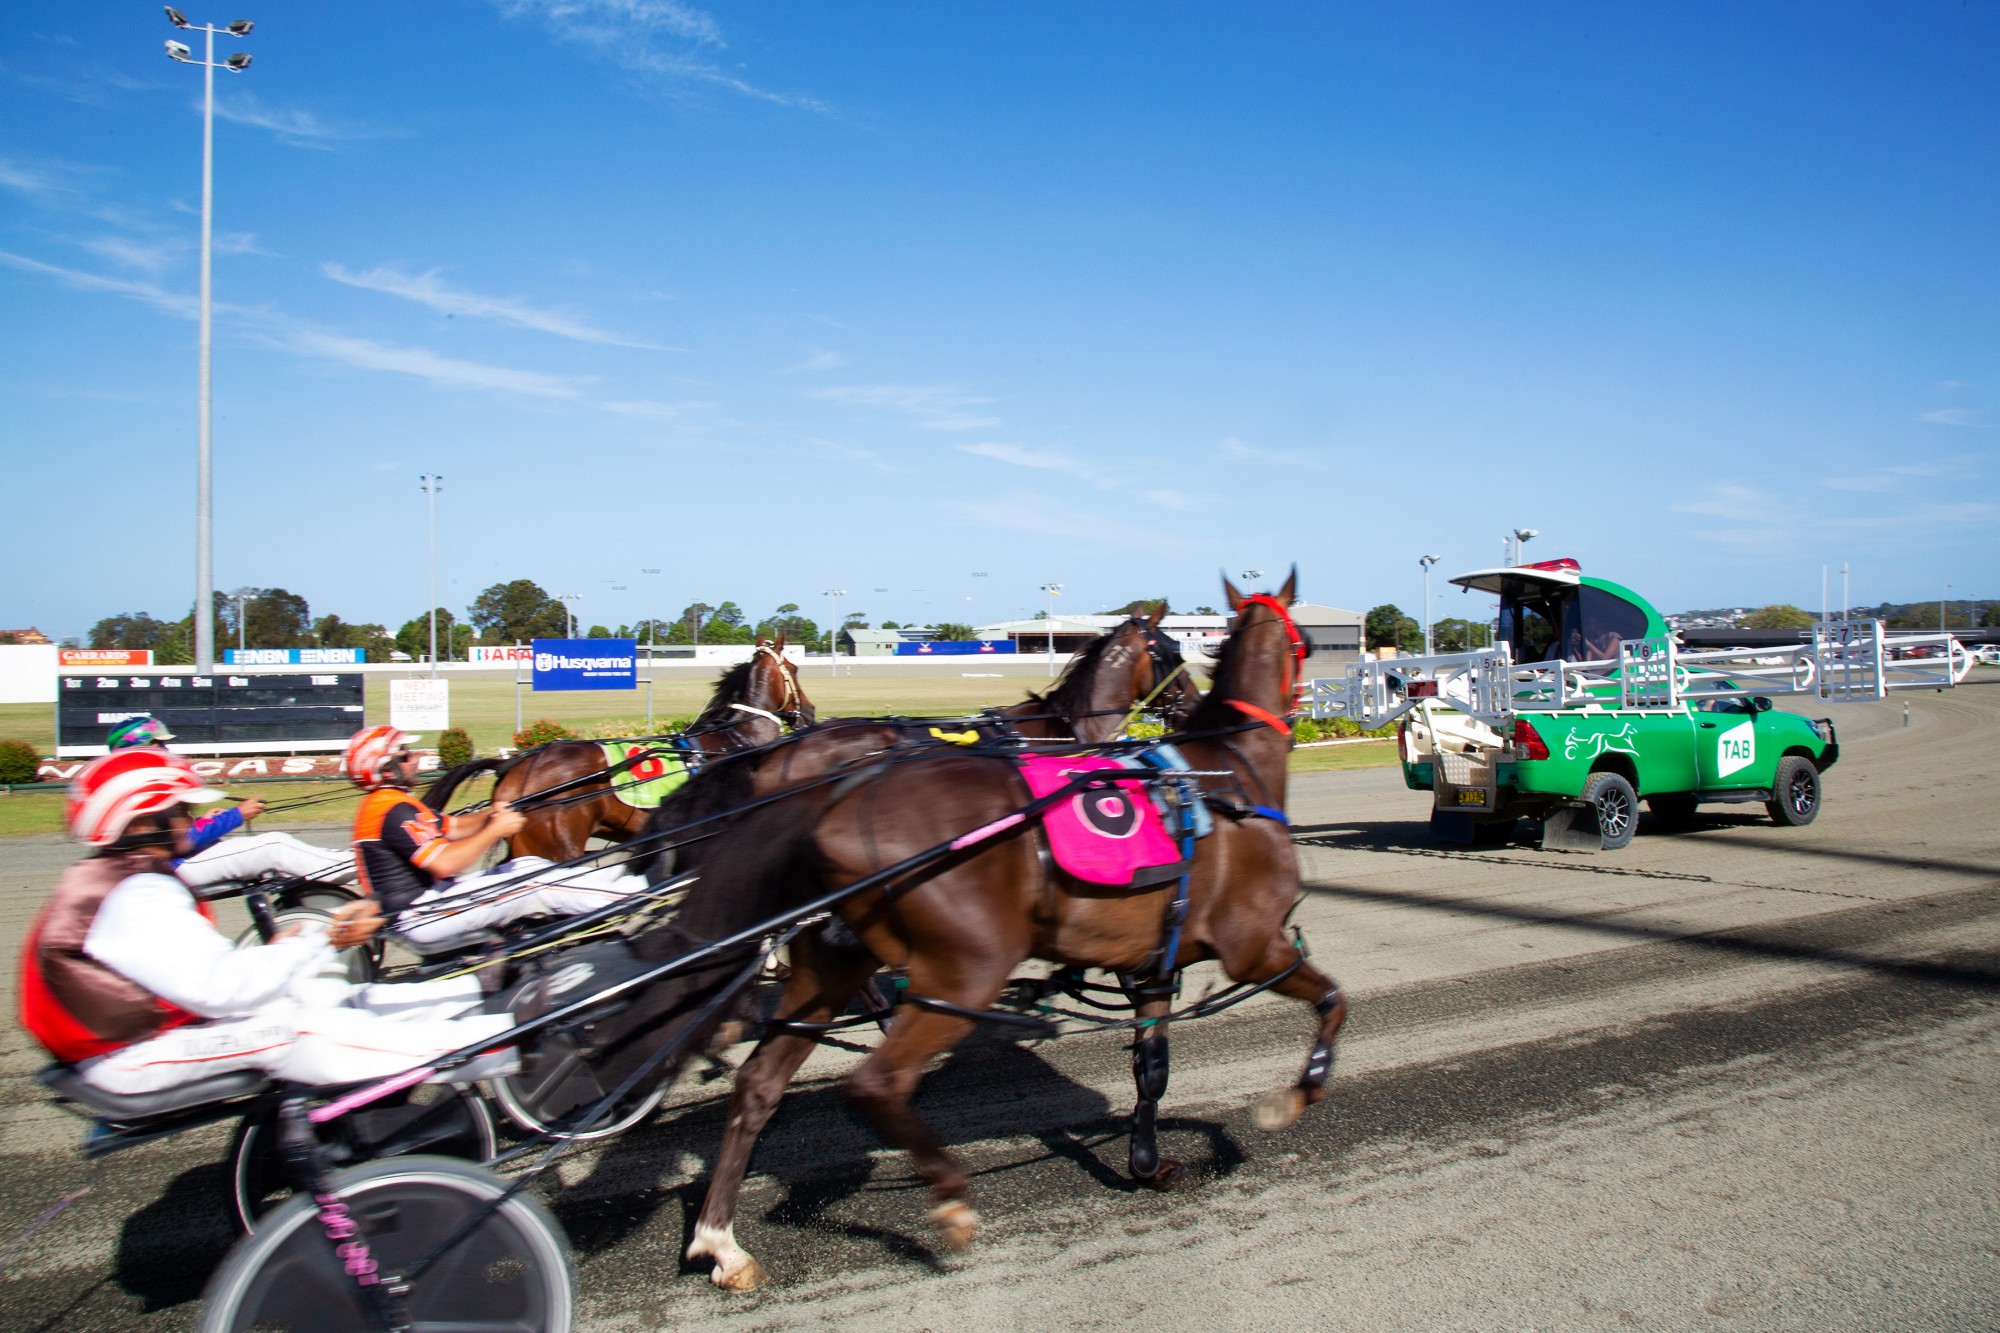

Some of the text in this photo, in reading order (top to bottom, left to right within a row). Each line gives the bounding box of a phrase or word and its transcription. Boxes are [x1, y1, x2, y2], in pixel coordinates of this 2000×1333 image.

[1840, 628, 1849, 641] 7
[253, 650, 290, 664] NBN
[318, 649, 356, 663] NBN
[1642, 645, 1649, 658] 6
[552, 656, 632, 671] Husqvarna
[1484, 658, 1490, 669] 5
[1357, 668, 1363, 678] 4
[310, 675, 339, 685] TIME
[1723, 740, 1750, 759] TAB
